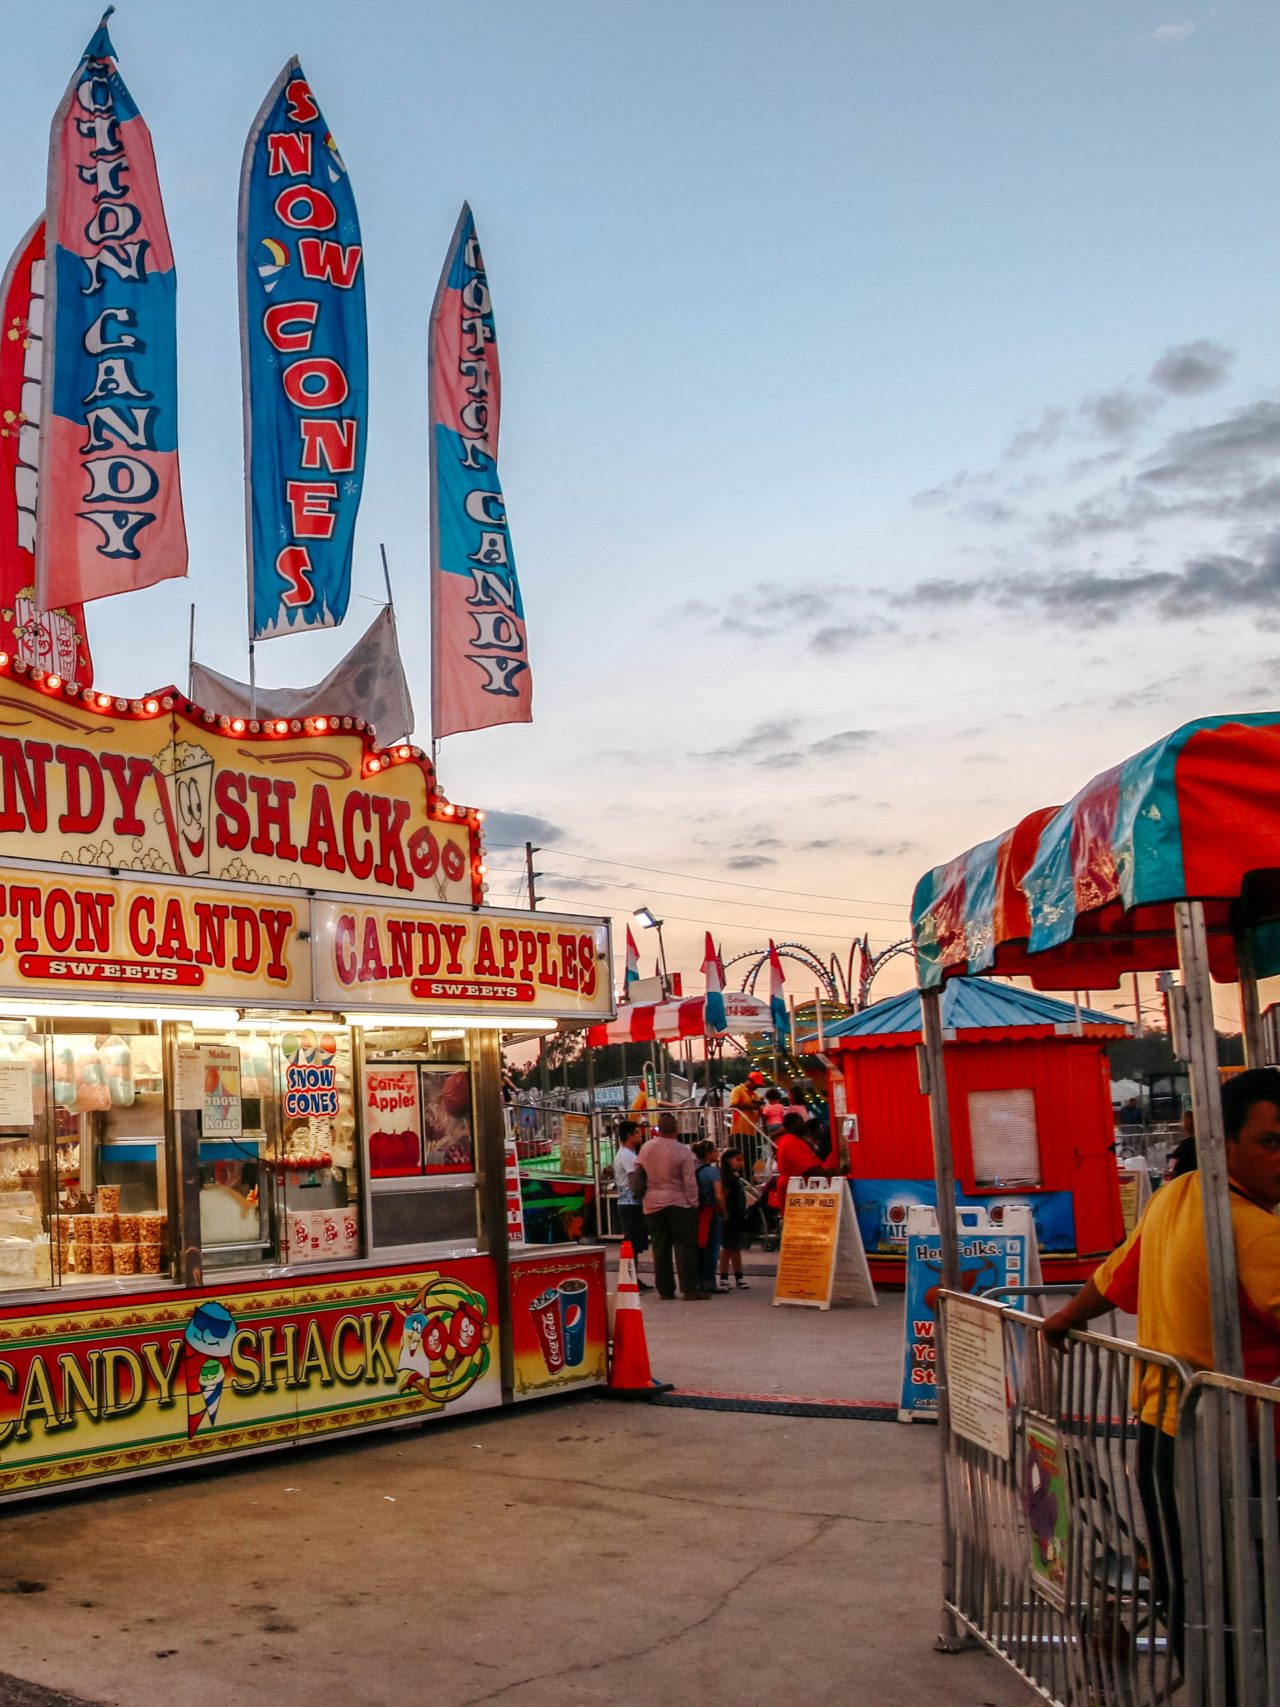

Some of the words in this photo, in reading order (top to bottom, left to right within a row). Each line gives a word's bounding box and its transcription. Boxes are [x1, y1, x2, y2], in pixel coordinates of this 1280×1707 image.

[73, 63, 150, 295] OTTON
[268, 78, 363, 290] SNOW
[76, 307, 159, 561] CANDY
[262, 300, 358, 608] CONES
[464, 488, 526, 698] CANDY
[214, 772, 415, 892] SHACK
[48, 960, 179, 982] SWEETS
[130, 893, 294, 982] CANDY
[335, 914, 467, 985] CANDY
[474, 925, 596, 997] APPLES
[431, 983, 518, 998] SWEETS
[286, 1090, 338, 1115] CONES
[288, 1067, 334, 1089] SNOW
[367, 1074, 414, 1094] Candy
[368, 1092, 416, 1113] Apples
[204, 1114, 239, 1130] Kone
[230, 1313, 397, 1394] SHACK
